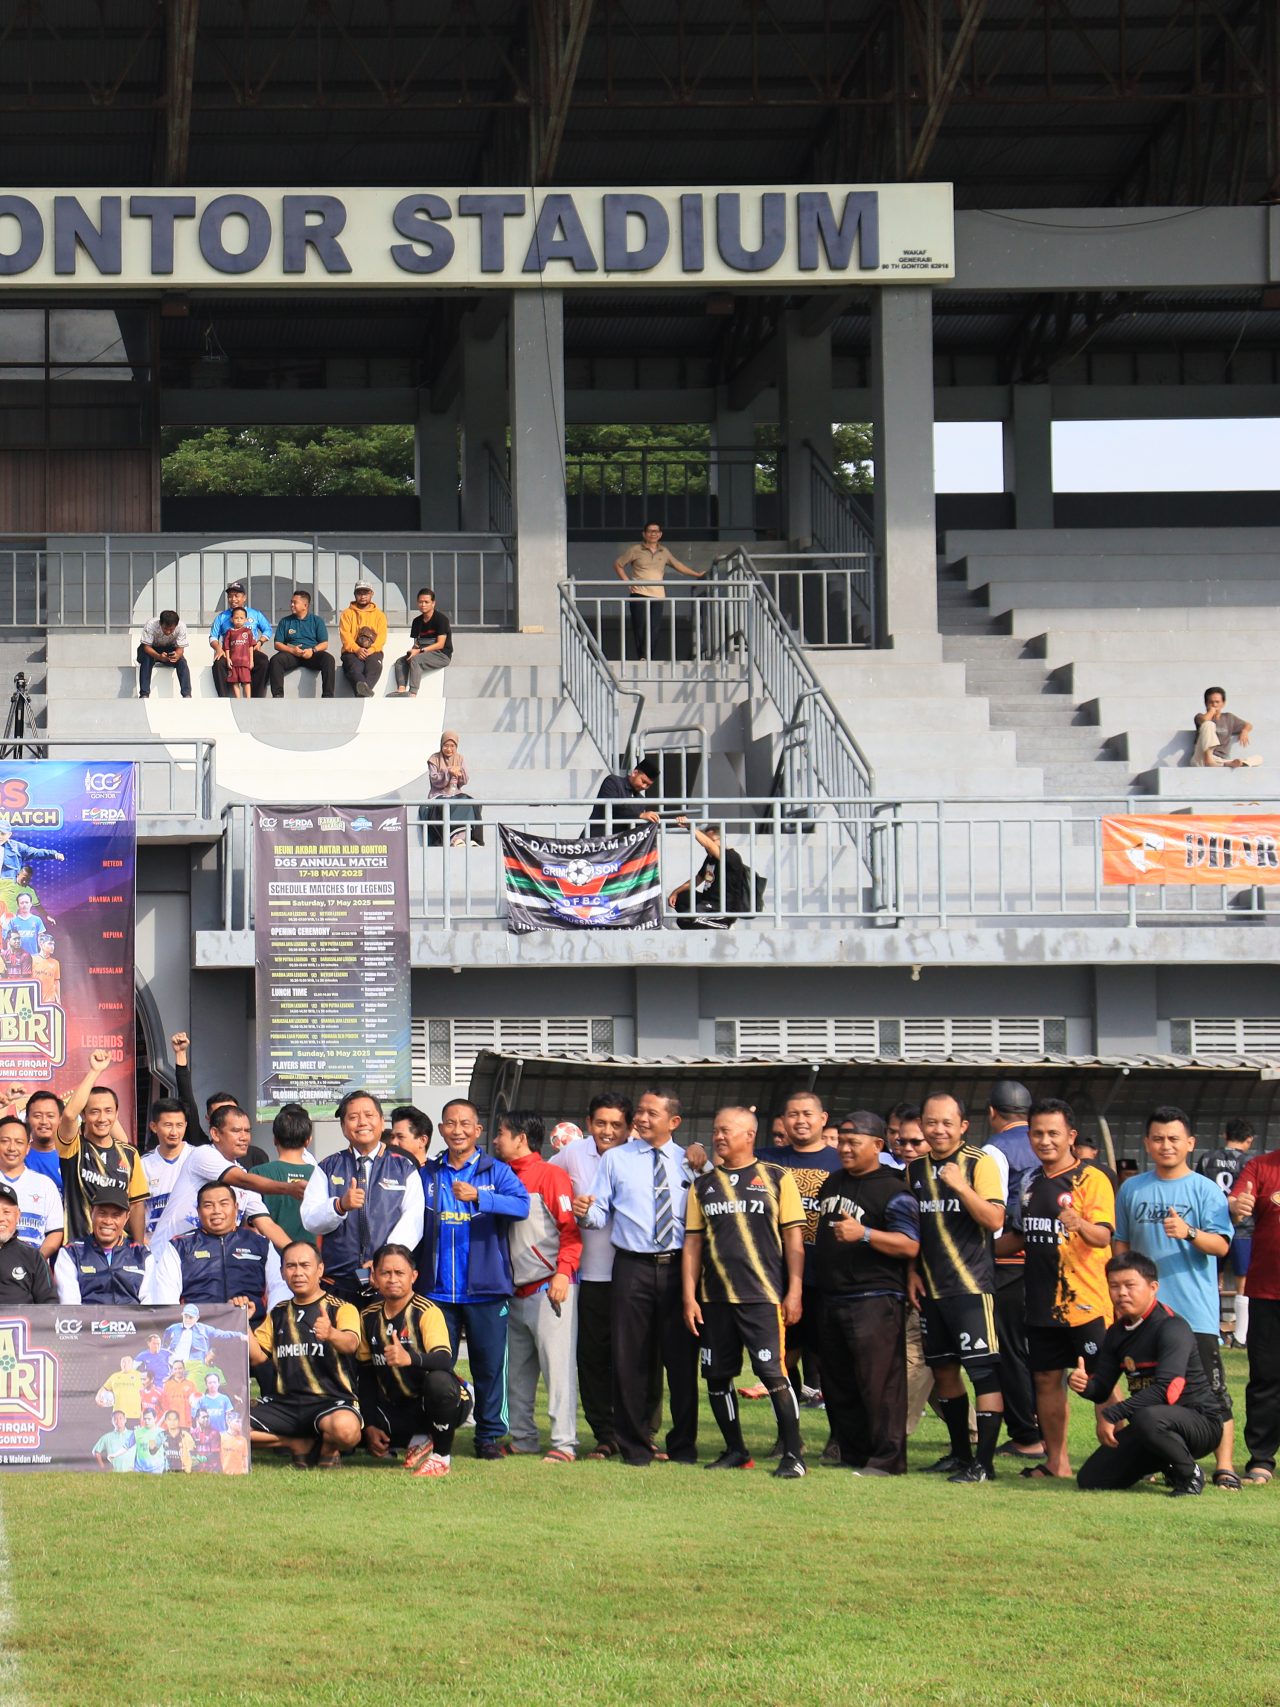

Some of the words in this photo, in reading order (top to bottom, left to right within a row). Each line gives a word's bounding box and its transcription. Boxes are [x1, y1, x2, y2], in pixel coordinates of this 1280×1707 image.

[390, 191, 880, 274] STADIUM
[274, 845, 294, 854] REUNI
[295, 845, 317, 854] AKBAR
[319, 845, 341, 854] ANTAR
[342, 845, 360, 854] KLUB
[361, 845, 388, 854] GONTOR
[531, 839, 619, 855] DARUSSALAM
[275, 858, 297, 867] DGS
[300, 858, 346, 867] ANNUAL
[349, 858, 387, 867] MATCH
[270, 884, 307, 894] SCHEDULE
[309, 884, 345, 894] MATCHES
[347, 884, 357, 894] for
[360, 884, 393, 893] LEGENDS
[270, 927, 296, 936] OPENING
[297, 927, 331, 936] CEREMONY
[271, 988, 291, 997] LUNCH
[292, 988, 308, 997] TIME
[81, 1035, 124, 1047] LEGENDS
[17, 1060, 48, 1068] FIRQAH
[272, 1061, 299, 1070] PLAYERS
[300, 1061, 316, 1070] MEET
[317, 1061, 327, 1070] UP
[298, 1090, 332, 1099] CEREMONY
[100, 1152, 108, 1165] 4
[729, 1173, 740, 1187] 9
[704, 1201, 746, 1217] ARMEKI
[749, 1199, 765, 1215] 71
[946, 1199, 961, 1213] 71
[297, 1310, 305, 1323] 7
[91, 1319, 137, 1332] FORDA
[386, 1322, 394, 1336] 8
[960, 1332, 972, 1351] 2
[311, 1343, 325, 1357] 71
[9, 1455, 31, 1463] Maidan
